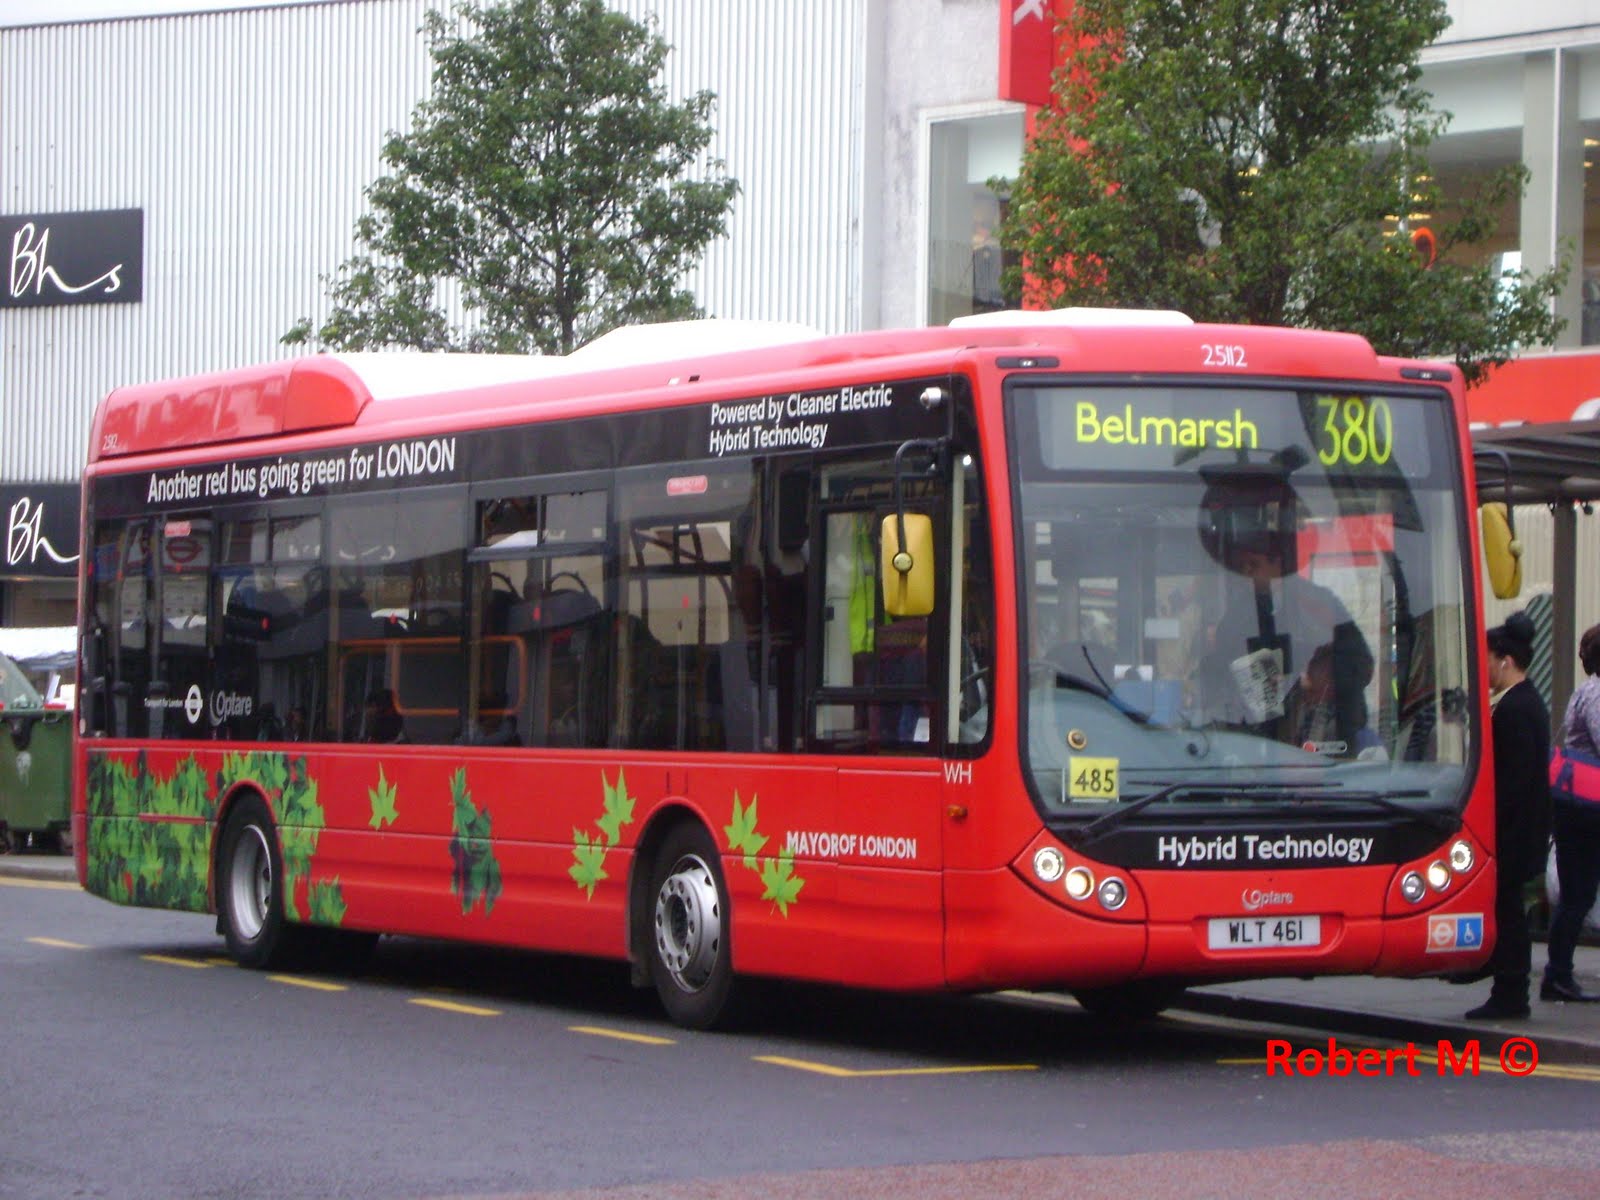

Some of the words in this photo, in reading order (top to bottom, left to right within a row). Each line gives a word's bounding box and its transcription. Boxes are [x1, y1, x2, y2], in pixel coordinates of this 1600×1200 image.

[10, 222, 123, 298] Bhs
[1201, 344, 1248, 368] 25112
[711, 397, 765, 426] Powered
[768, 397, 785, 423] by
[787, 392, 840, 418] Cleaner
[841, 383, 893, 412] Electric
[709, 426, 750, 457] Hybrid
[753, 421, 829, 449] Technology
[1076, 401, 1258, 449] Belmarsh
[1317, 396, 1393, 466] 380
[147, 471, 203, 503] Another
[206, 464, 228, 495] red
[232, 462, 256, 493] bus
[259, 457, 300, 498] going
[302, 458, 345, 494] green
[349, 447, 374, 481] for
[377, 437, 456, 478] LONDON
[7, 496, 81, 566] Bh
[943, 763, 972, 785] WH
[1075, 769, 1115, 794] 485
[859, 835, 917, 860] LONDON
[1158, 836, 1237, 867] Hybrid
[1244, 834, 1374, 863] Technology
[1229, 921, 1267, 945] WLT
[1272, 920, 1303, 941] 461
